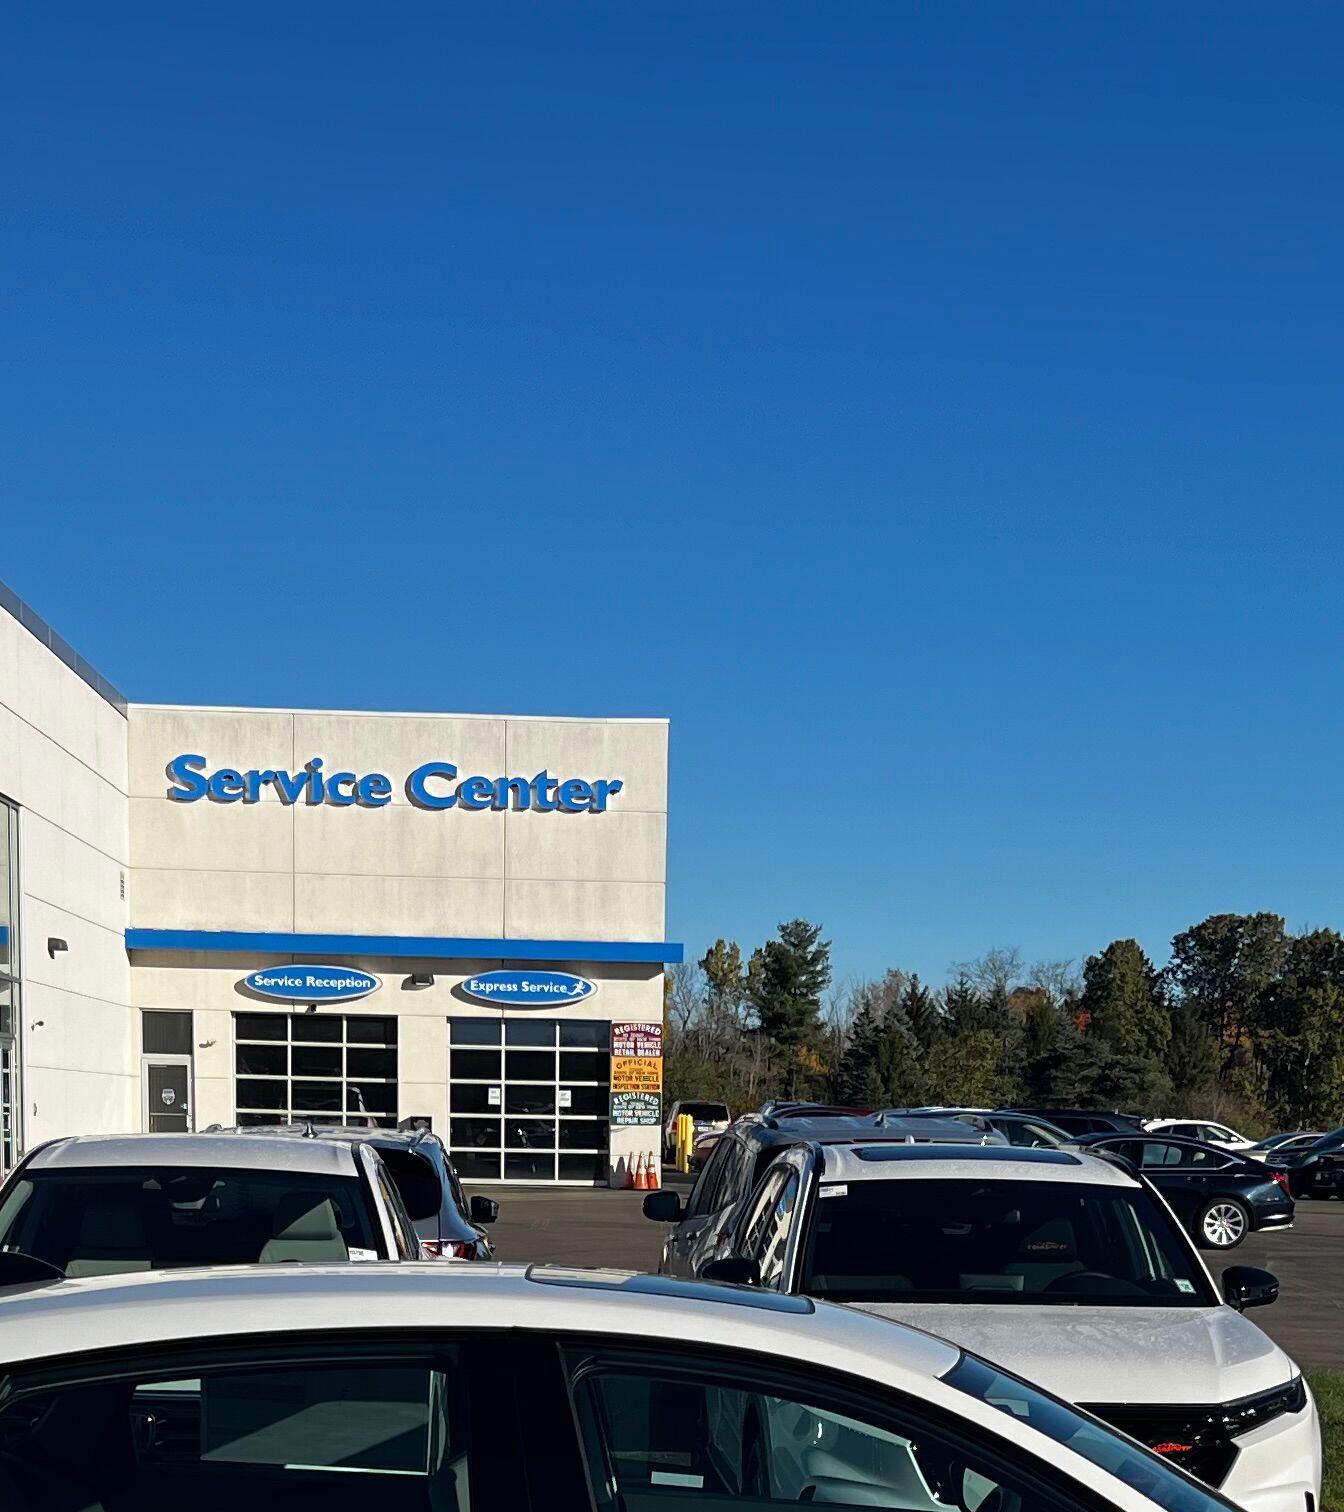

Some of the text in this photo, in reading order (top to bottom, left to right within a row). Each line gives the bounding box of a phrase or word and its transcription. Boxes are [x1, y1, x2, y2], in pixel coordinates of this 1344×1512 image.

[167, 754, 623, 812] Service Center
[254, 975, 371, 990] Service Reception
[470, 980, 568, 994] Express Service
[614, 1023, 661, 1035] REGISTERED
[616, 1059, 657, 1070] OFFICIAL
[613, 1092, 659, 1104] REGISTERED
